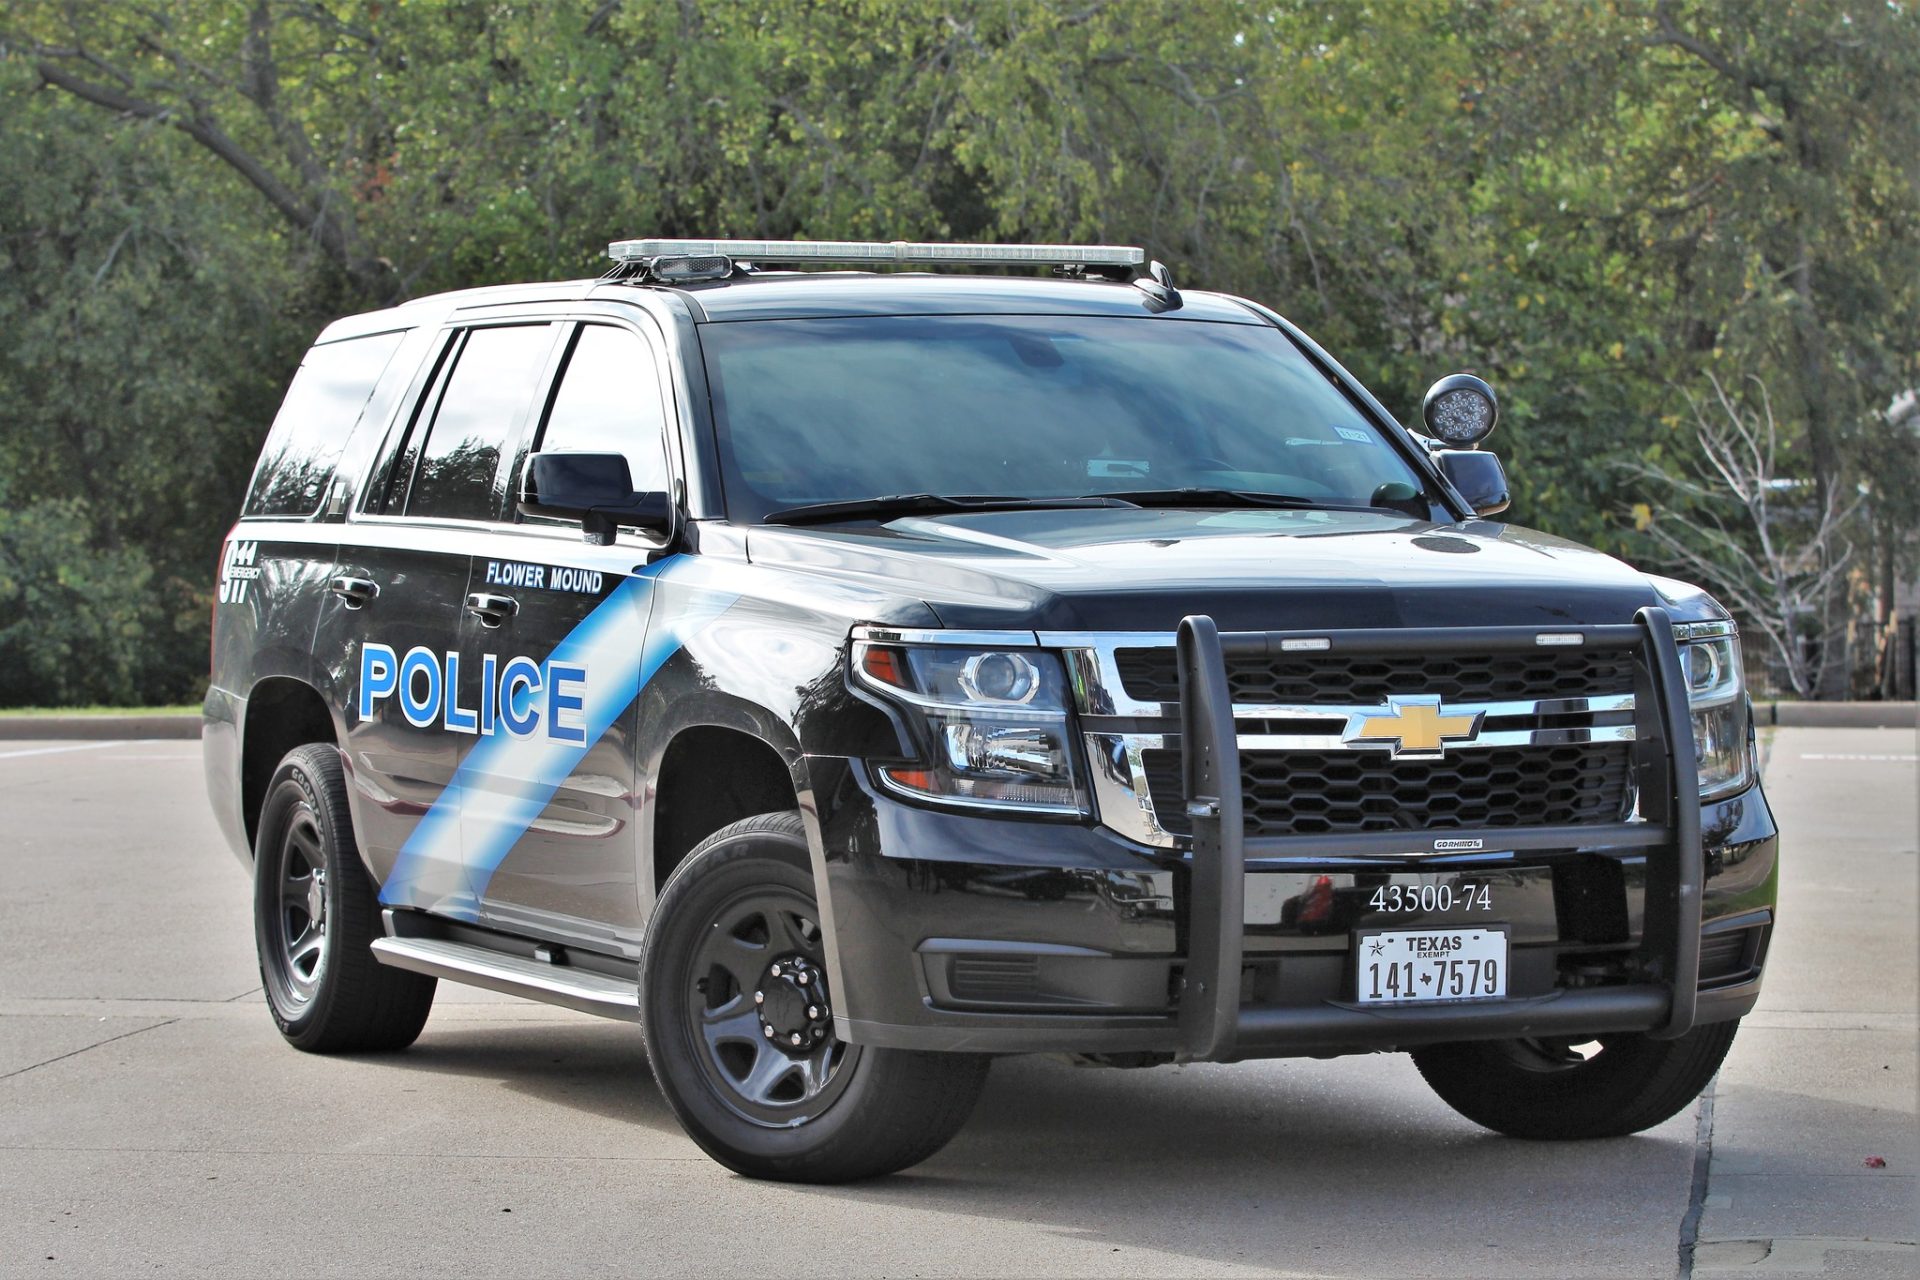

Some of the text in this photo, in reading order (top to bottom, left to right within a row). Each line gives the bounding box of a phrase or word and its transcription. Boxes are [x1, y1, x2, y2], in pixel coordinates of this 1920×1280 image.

[486, 561, 602, 594] FLOWER MOUND
[359, 642, 588, 748] POLICE
[1369, 884, 1491, 912] 43500-74
[1406, 936, 1462, 951] TEXAS
[1416, 951, 1451, 959] EXEMPT
